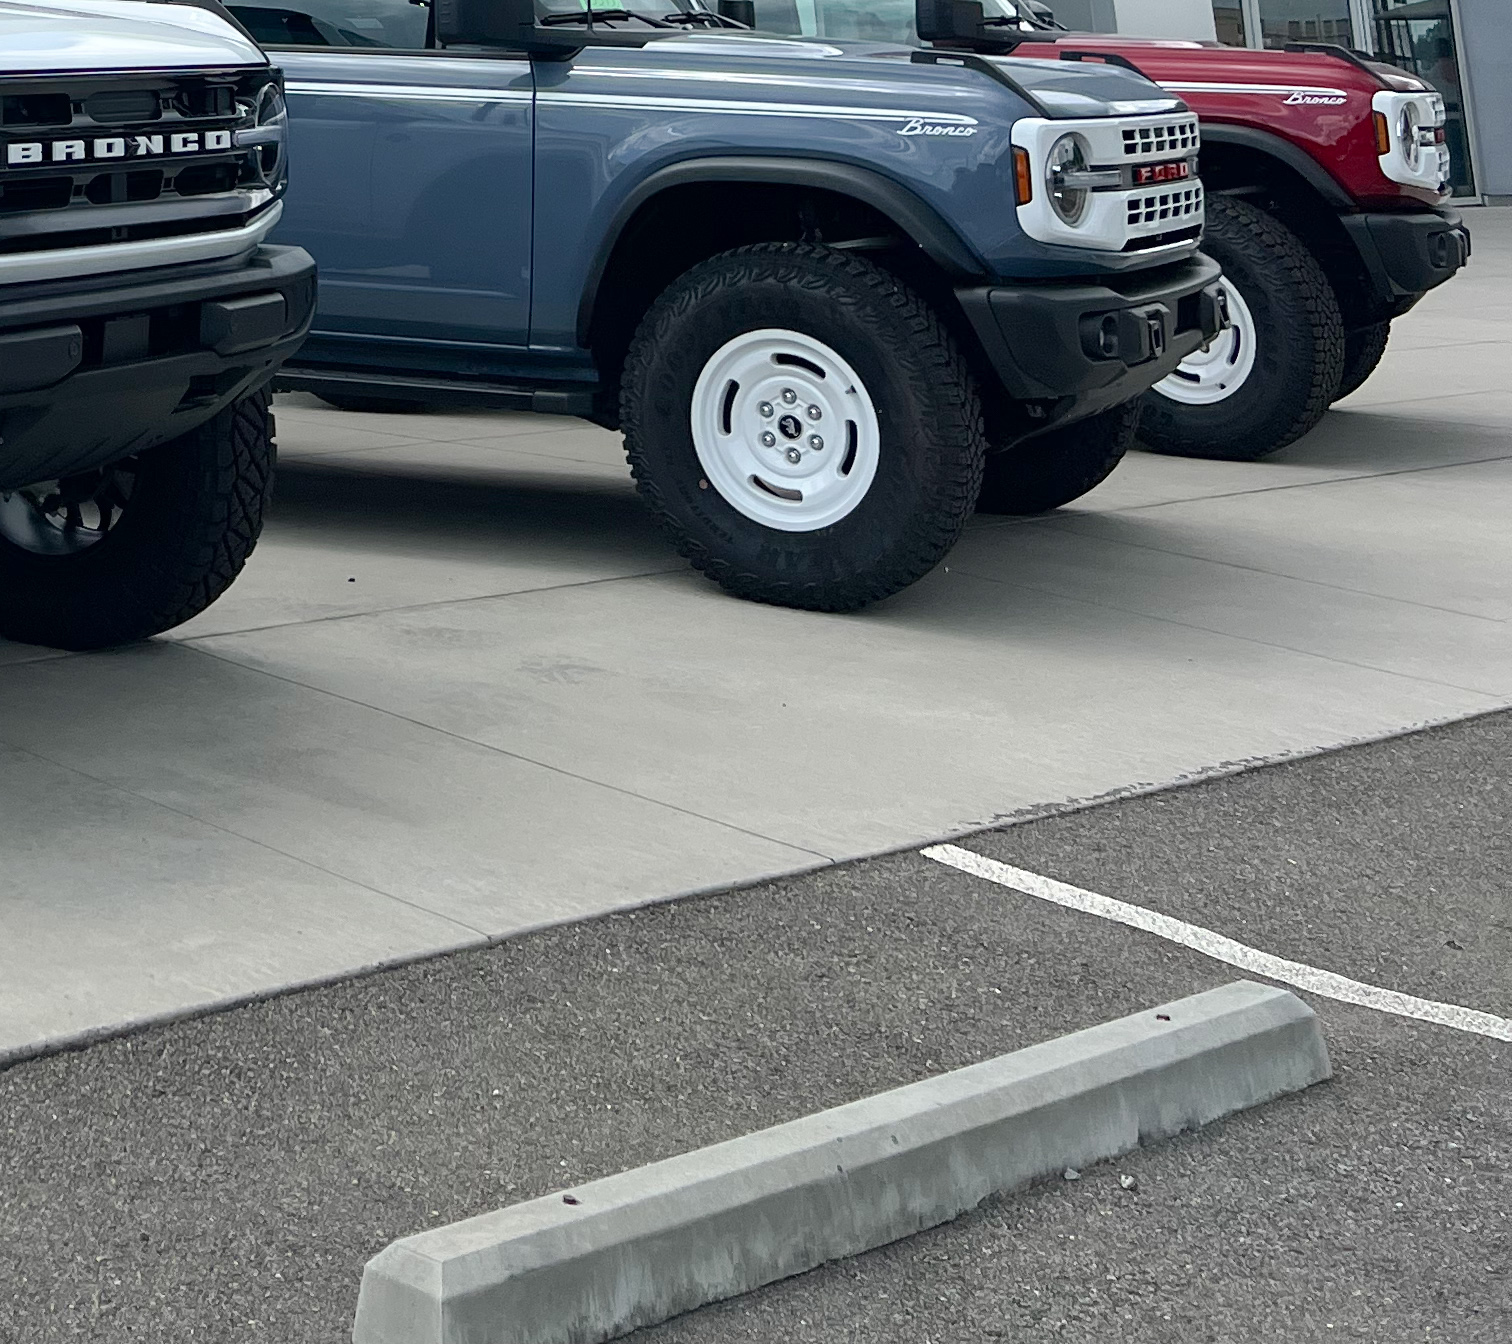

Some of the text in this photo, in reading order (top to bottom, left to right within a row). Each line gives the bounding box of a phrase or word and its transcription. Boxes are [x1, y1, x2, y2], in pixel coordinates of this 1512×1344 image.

[1282, 90, 1348, 105] Bronco
[896, 117, 978, 137] Bronco
[7, 130, 232, 164] BRONCO
[1136, 161, 1189, 184] FORD
